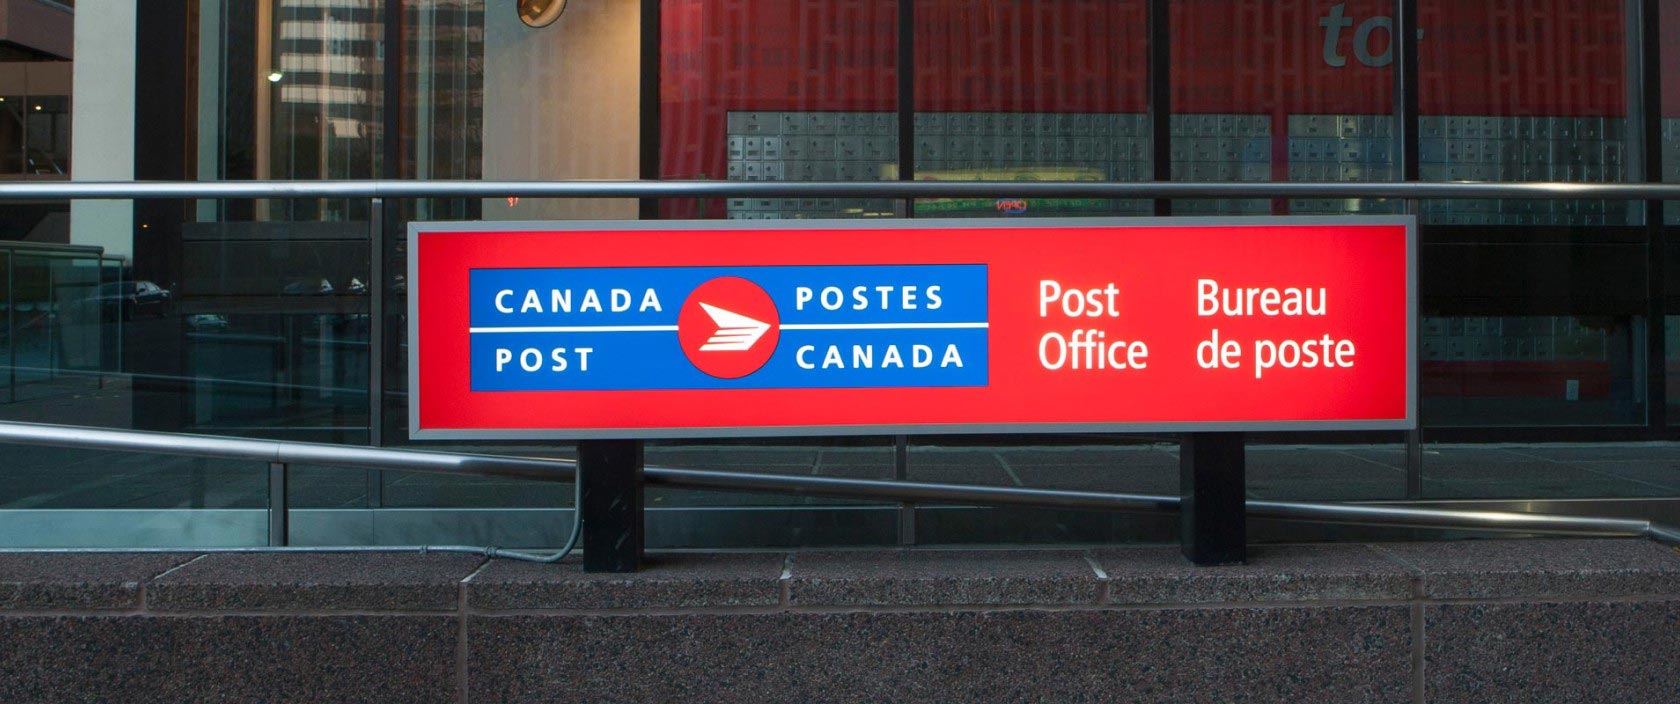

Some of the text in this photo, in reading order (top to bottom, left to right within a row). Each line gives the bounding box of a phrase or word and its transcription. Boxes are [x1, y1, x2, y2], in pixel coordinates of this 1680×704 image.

[494, 287, 664, 314] CANADA
[795, 284, 943, 312] POSTES
[1039, 279, 1120, 318] Post
[1196, 278, 1327, 317] Bureau
[495, 346, 594, 373] POST
[795, 342, 964, 370] CANADA
[1038, 328, 1149, 370] Office
[1196, 328, 1356, 379] de poste
